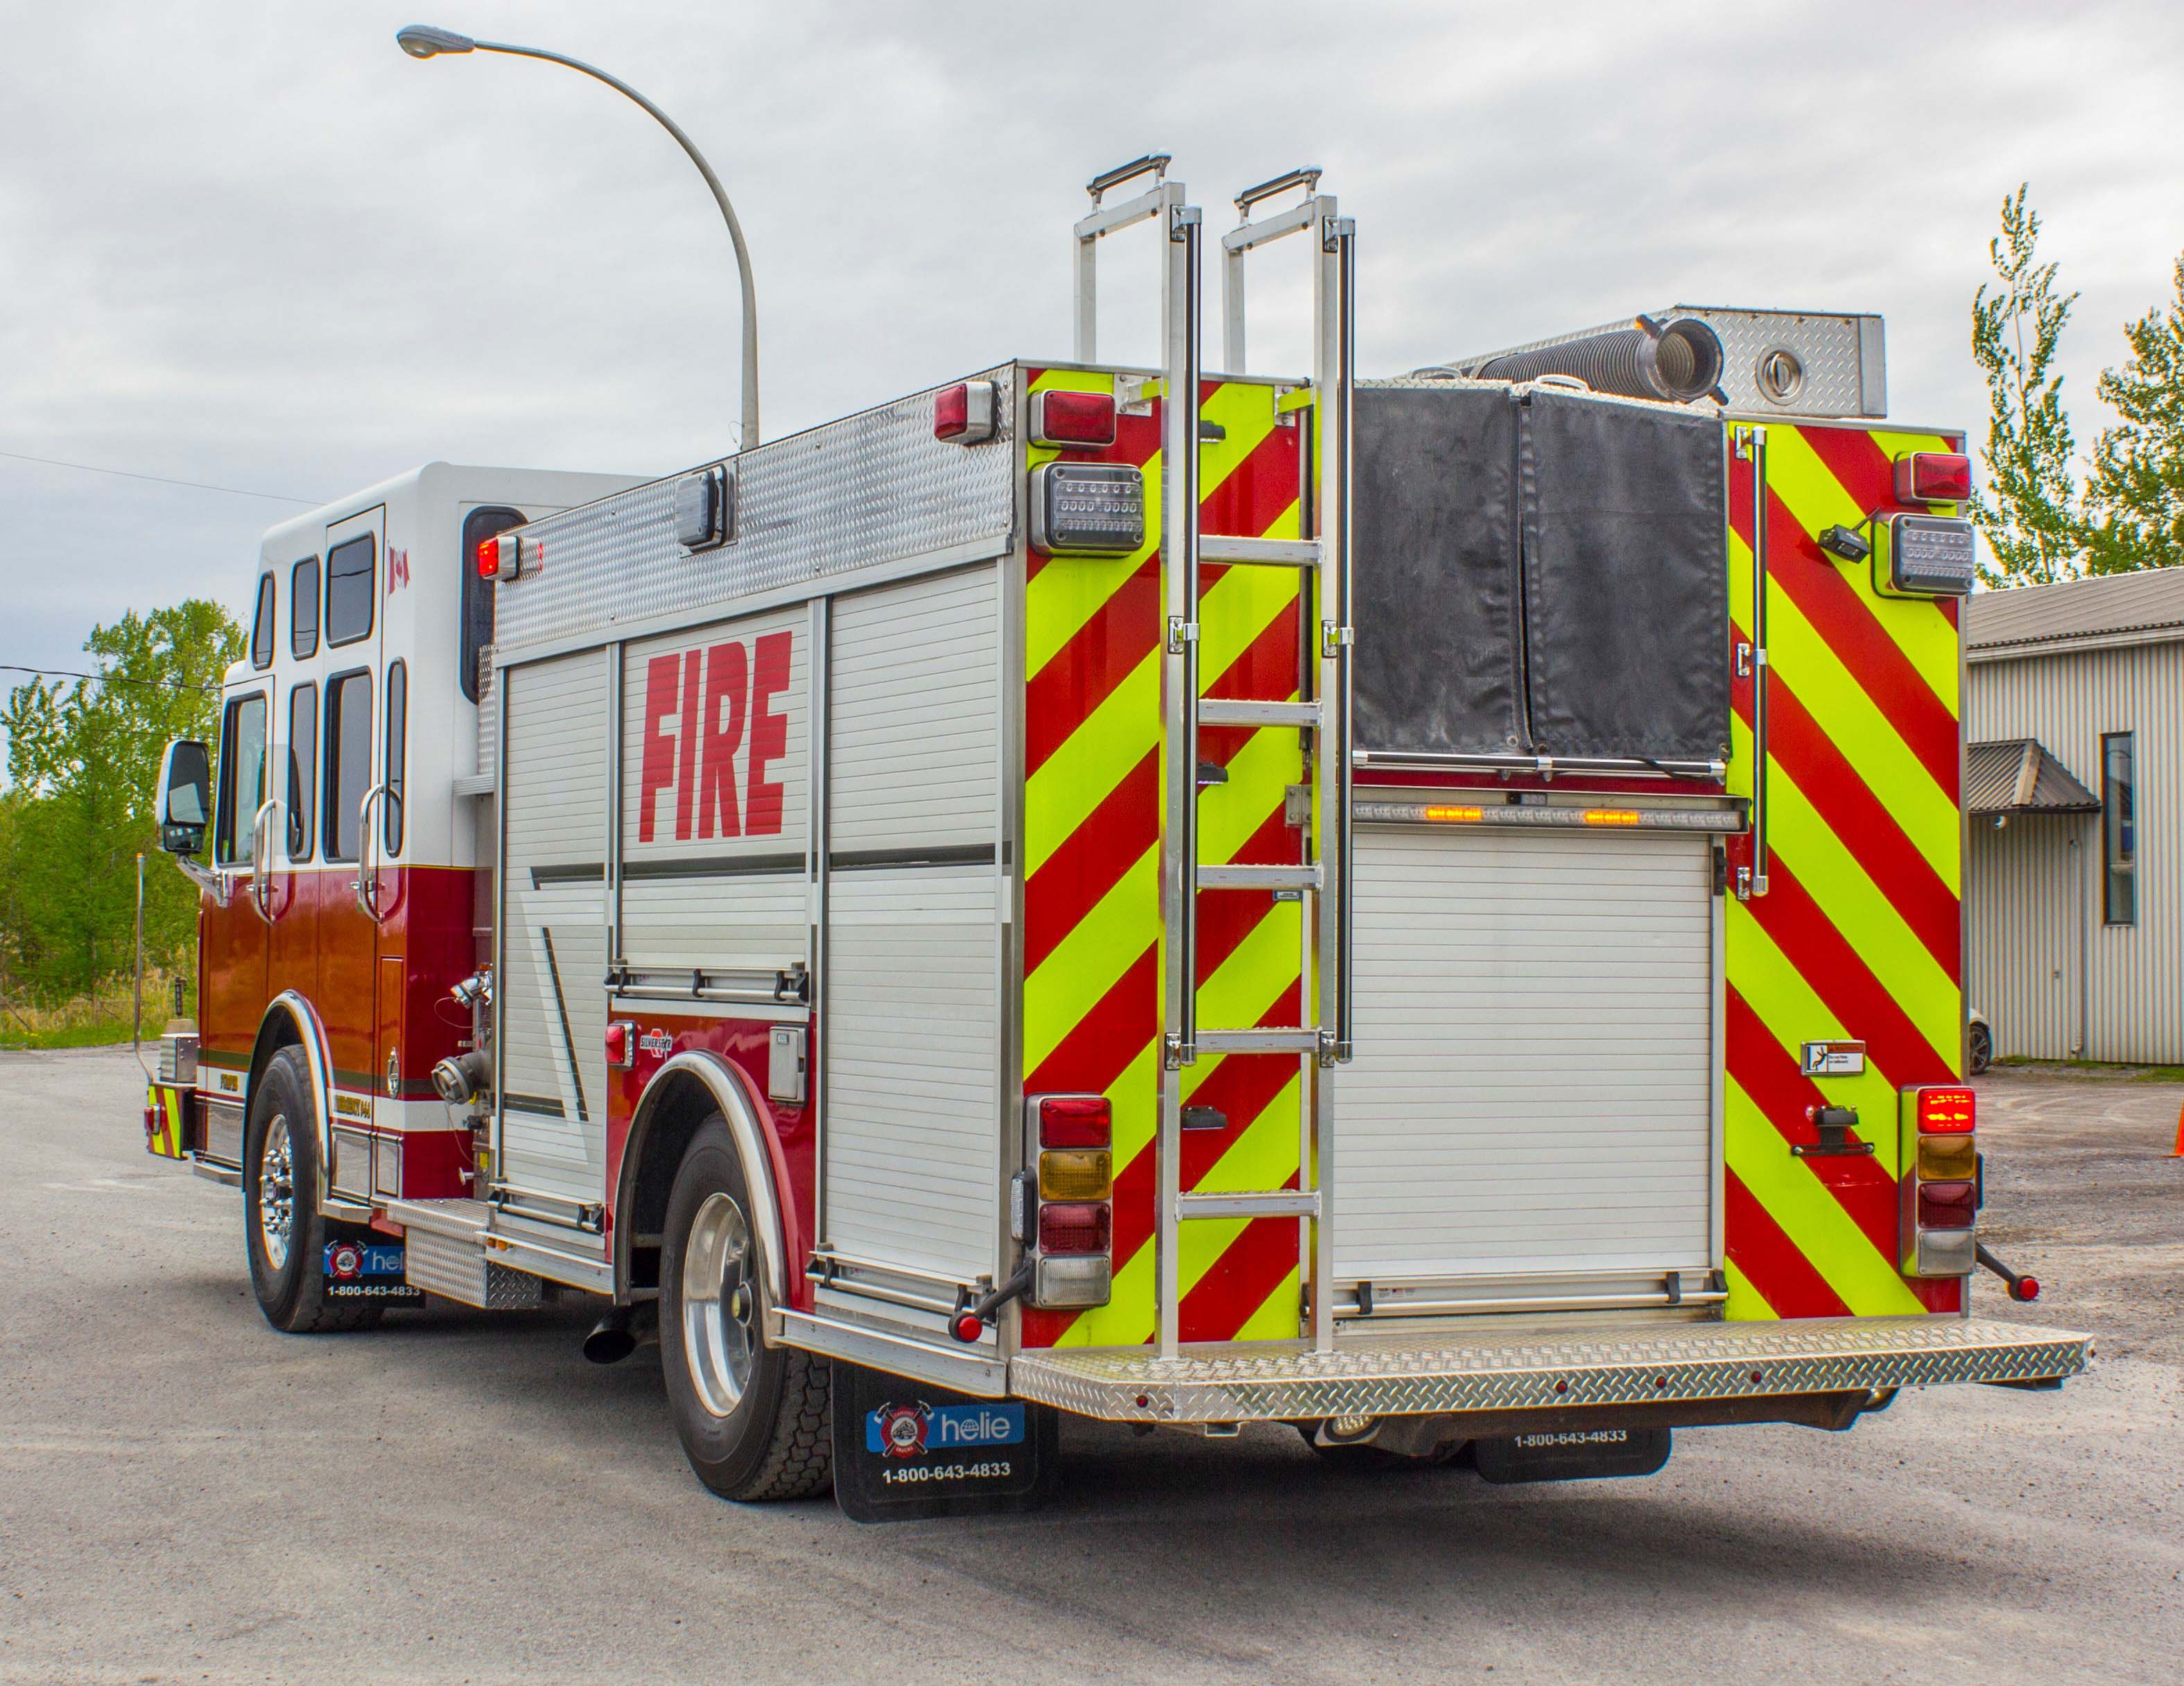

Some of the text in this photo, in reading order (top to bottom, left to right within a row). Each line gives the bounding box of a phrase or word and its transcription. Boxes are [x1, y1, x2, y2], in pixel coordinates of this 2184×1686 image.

[639, 631, 792, 842] FIRE
[372, 1251, 405, 1271] hel
[328, 1286, 420, 1296] 1-800-643-4833
[942, 1411, 1010, 1441] helie
[1514, 1430, 1627, 1448] 1-800-643-4833
[883, 1462, 1011, 1484] 1-800-643-4833
